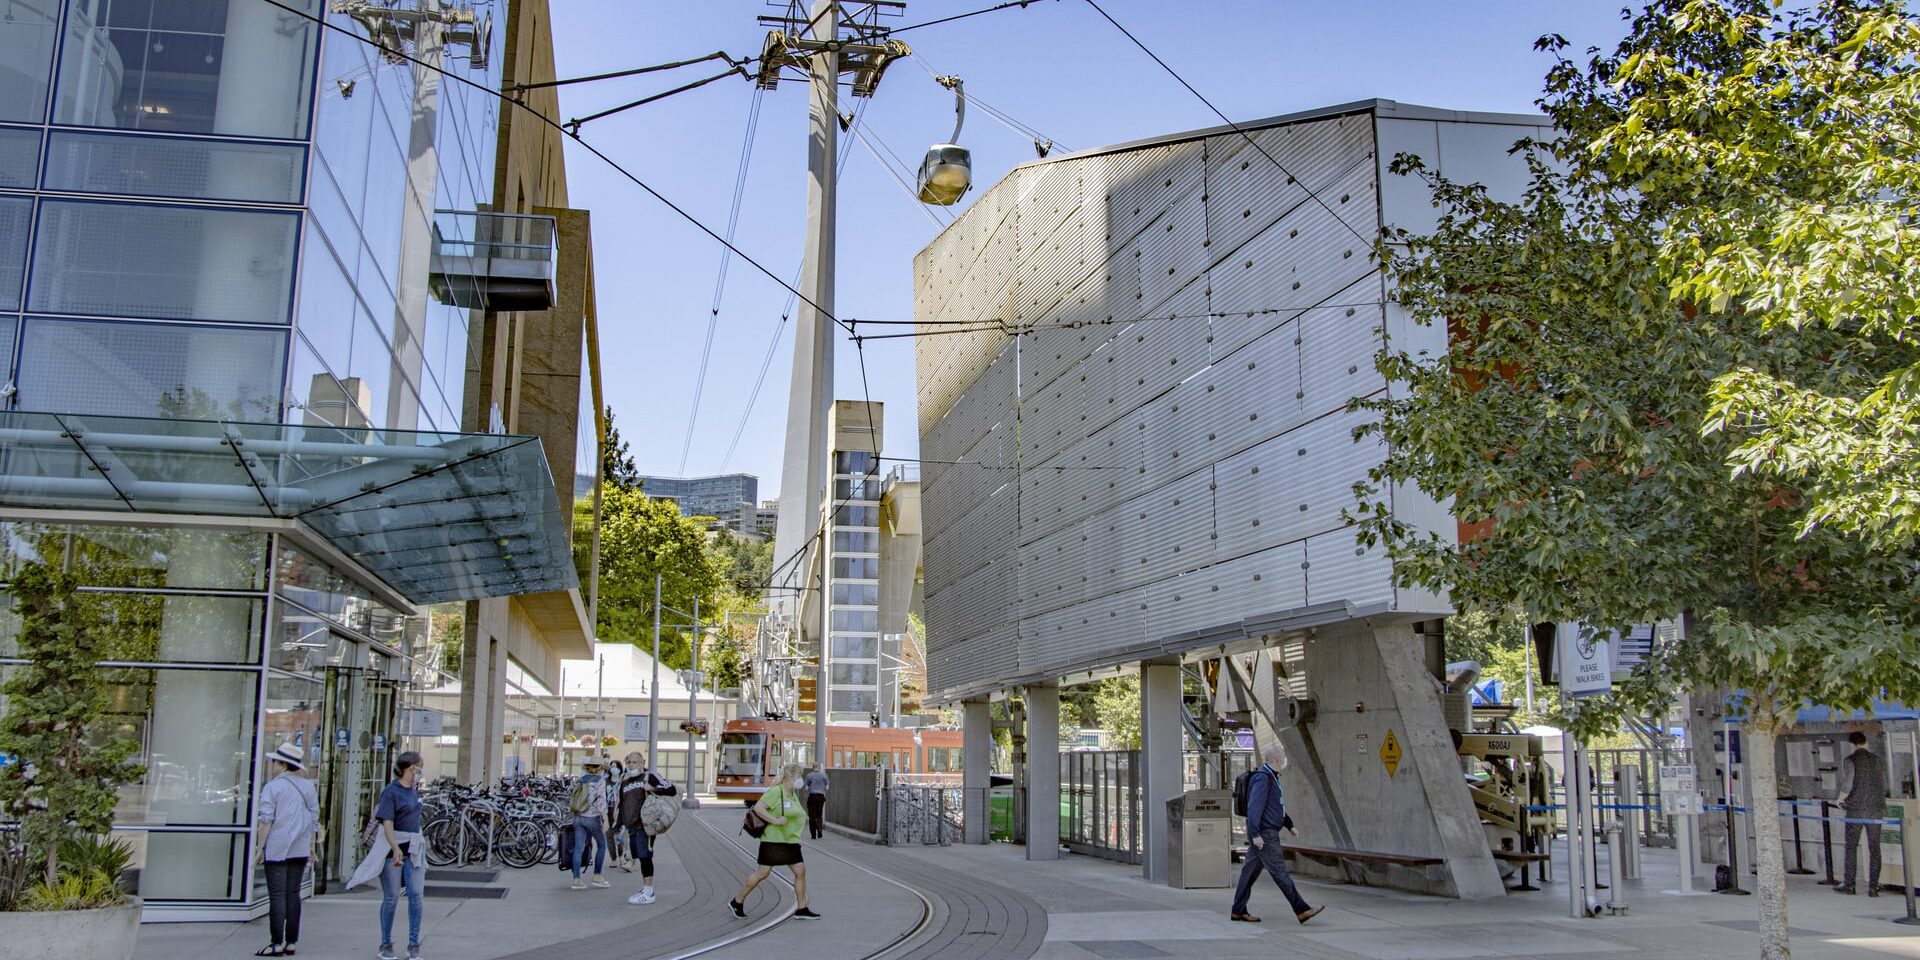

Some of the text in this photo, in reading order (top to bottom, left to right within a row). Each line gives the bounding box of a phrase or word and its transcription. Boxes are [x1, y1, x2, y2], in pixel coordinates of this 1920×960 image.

[1580, 663, 1598, 672] PLEASE
[1575, 673, 1605, 683] WALK BIKES
[1487, 740, 1511, 751] X600AJ
